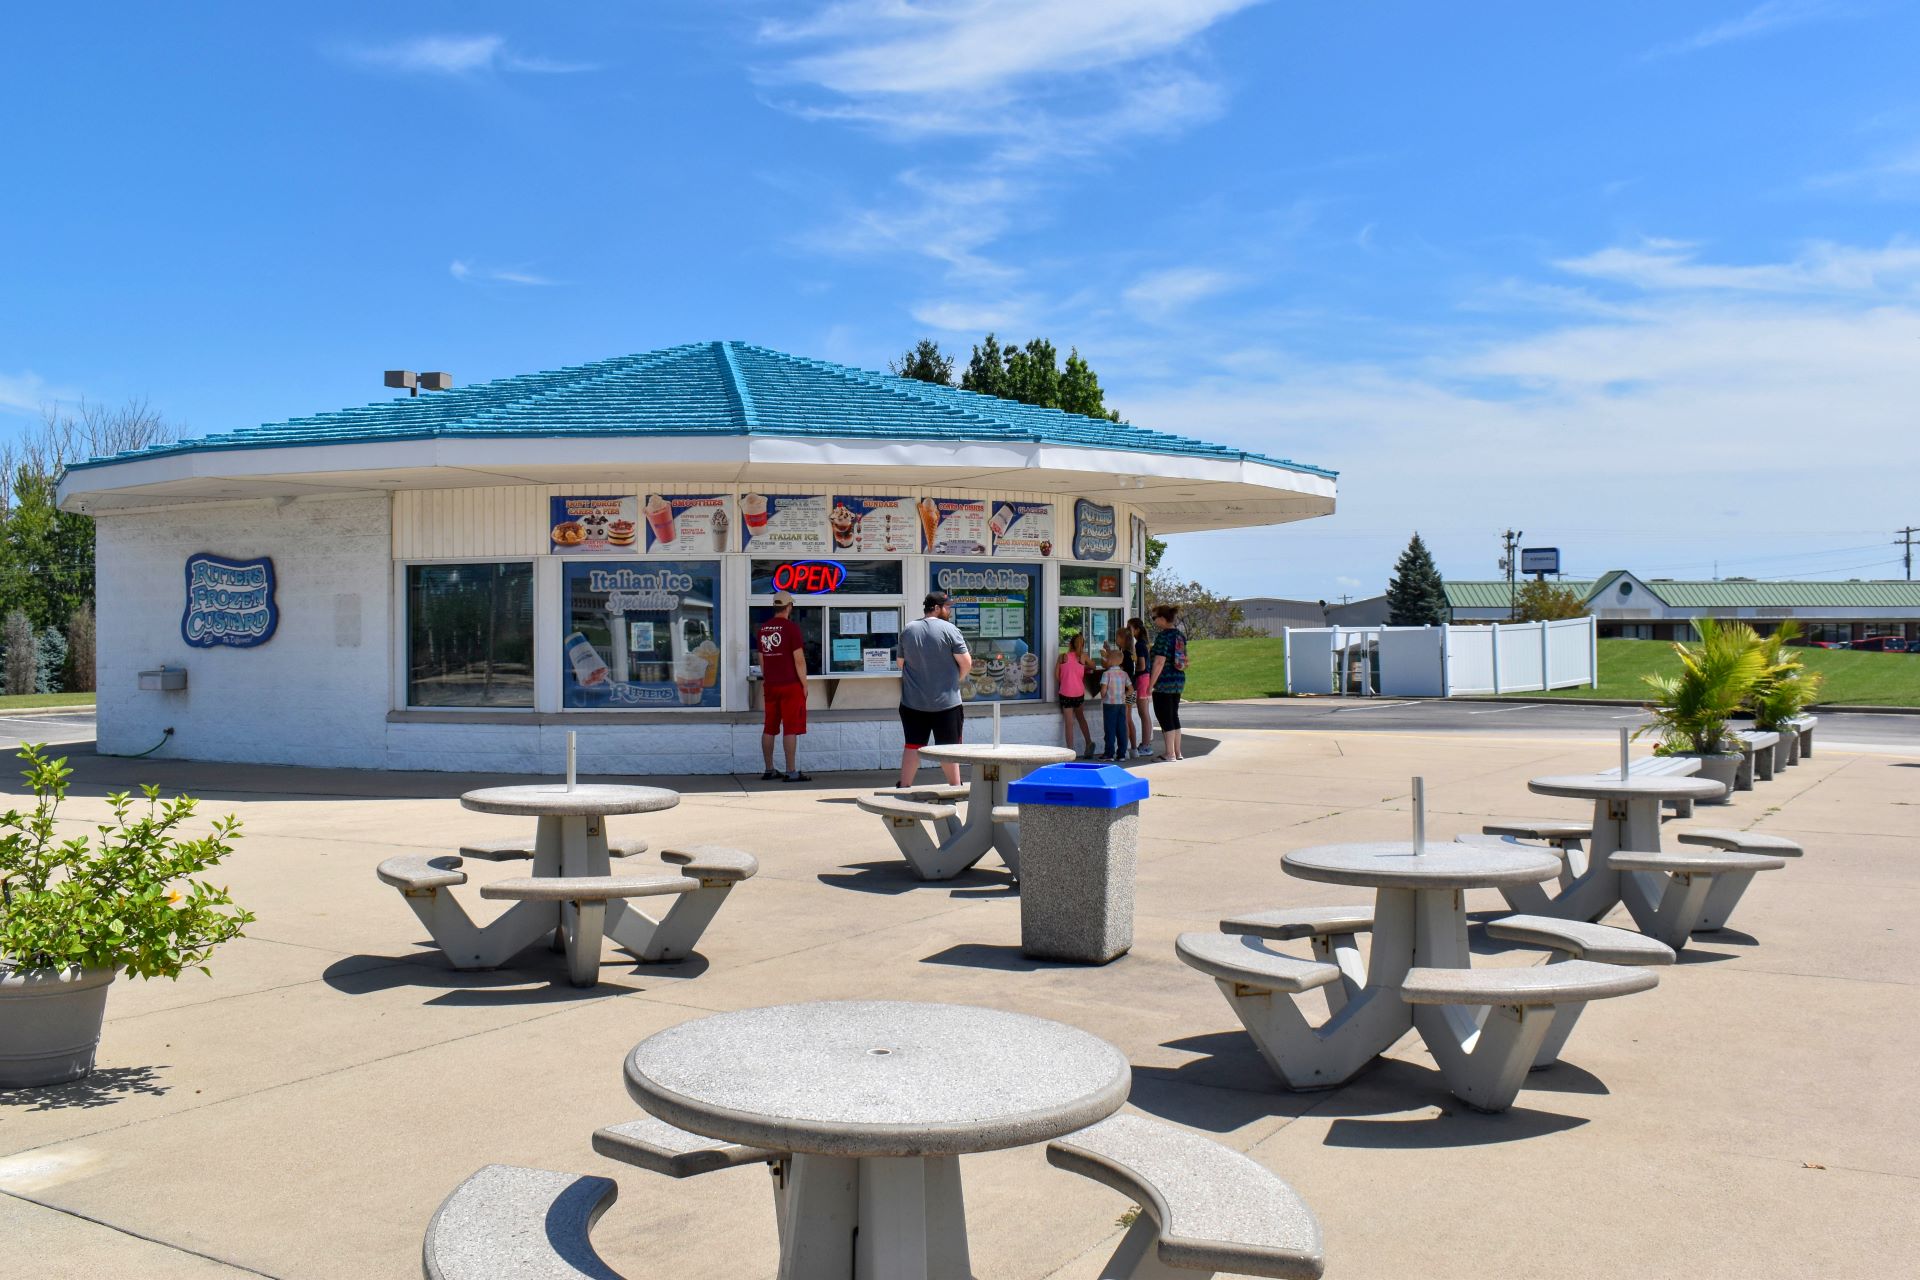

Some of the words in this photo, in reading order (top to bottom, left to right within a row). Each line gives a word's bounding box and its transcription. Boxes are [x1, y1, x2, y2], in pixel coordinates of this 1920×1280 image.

[672, 499, 724, 507] SMOOTHIES
[769, 533, 802, 541] ITALIAN
[804, 533, 819, 541] ICE
[1081, 521, 1113, 537] FROZEN
[1079, 537, 1114, 555] CUSTARD
[591, 570, 657, 592] Italian
[659, 570, 693, 592] Ice
[774, 564, 840, 592] OPEN
[938, 568, 983, 590] Cakes
[985, 569, 998, 590] &
[998, 569, 1029, 590] Pies
[192, 586, 266, 611] FROZEN
[606, 591, 679, 615] Specialties
[188, 609, 268, 638] CUSTARD
